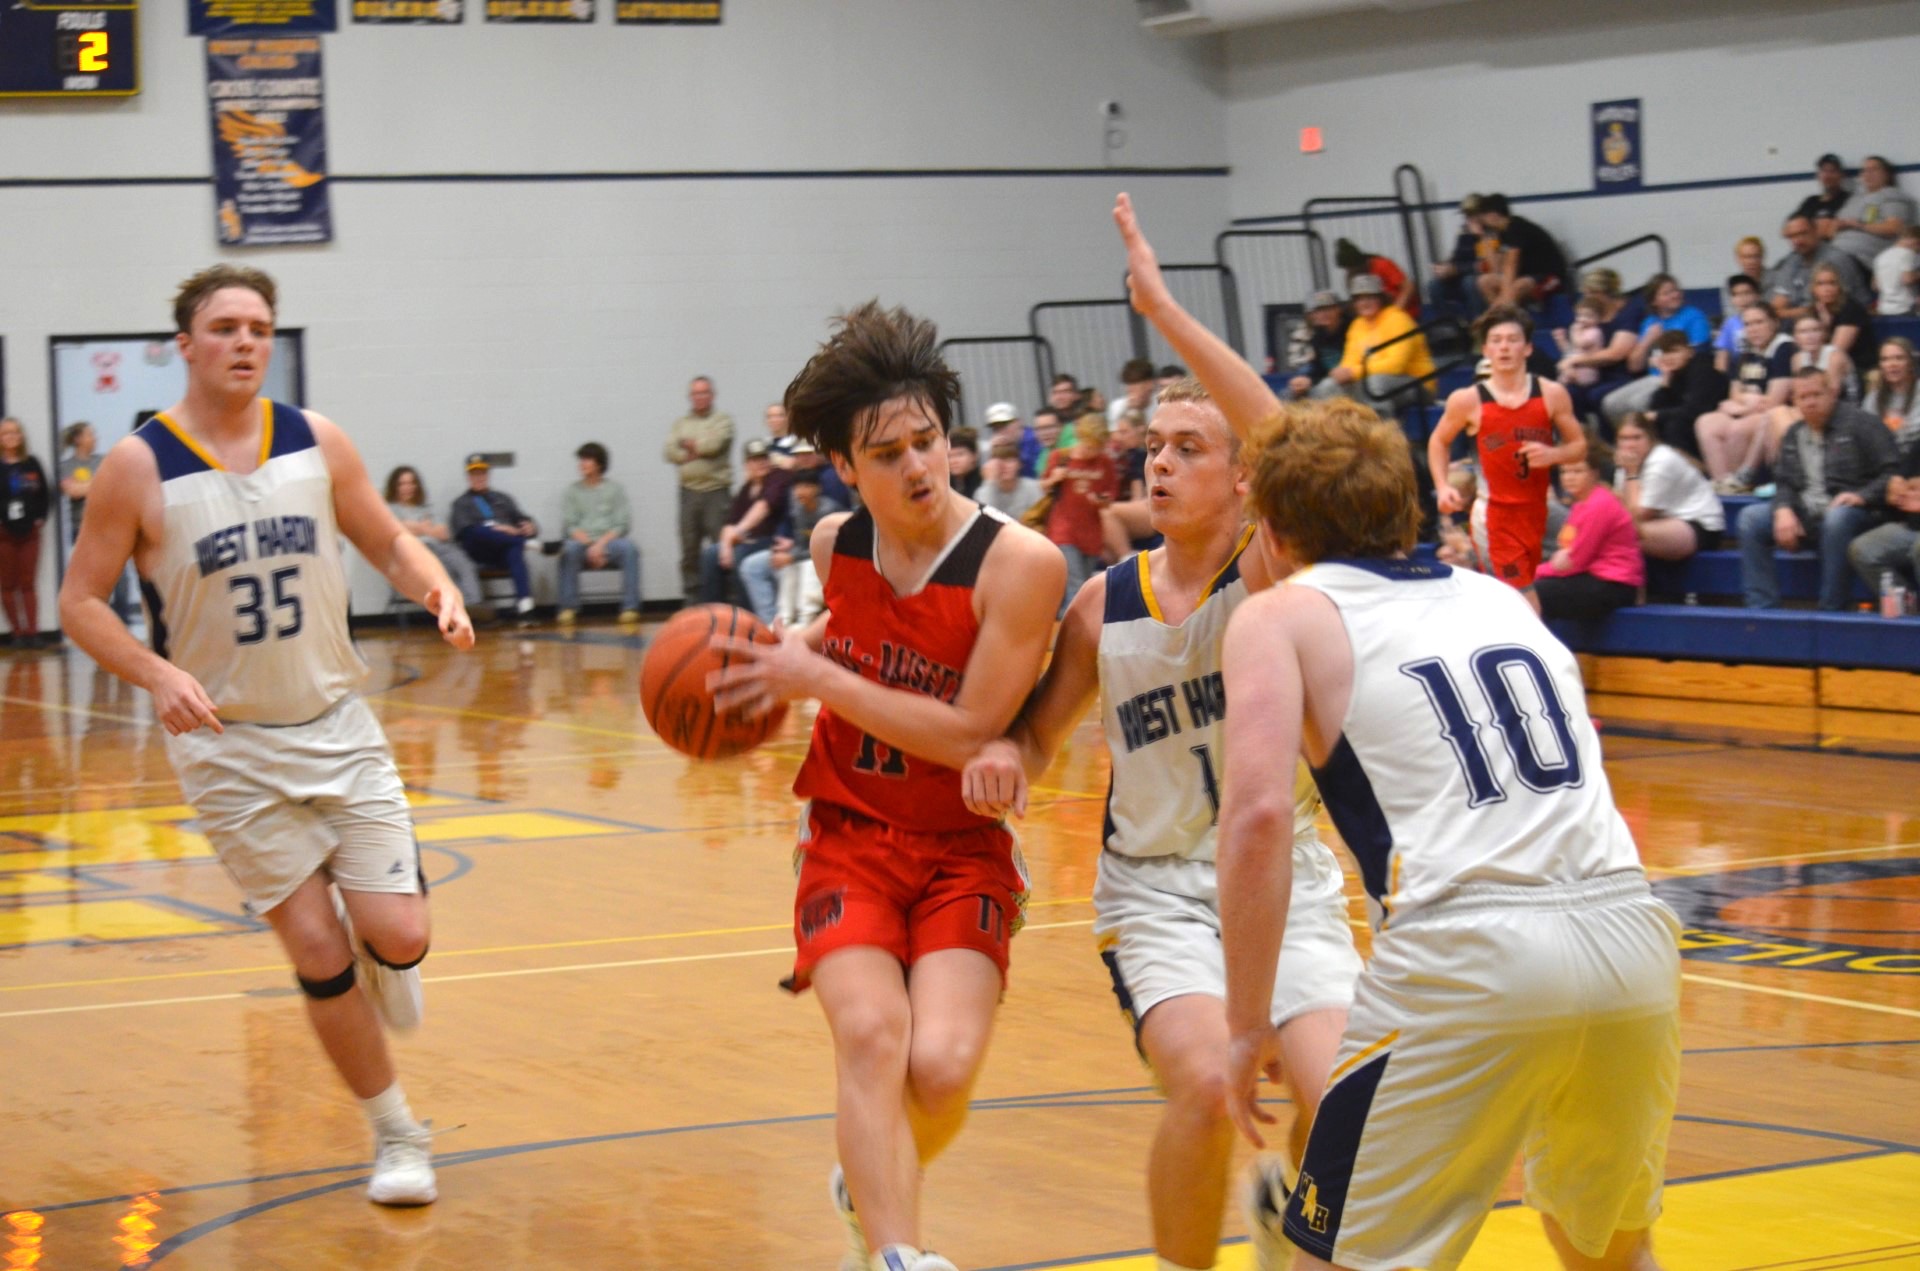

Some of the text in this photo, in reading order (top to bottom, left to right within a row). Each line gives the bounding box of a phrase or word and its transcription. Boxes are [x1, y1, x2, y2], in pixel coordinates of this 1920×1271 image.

[78, 31, 108, 72] 2
[194, 523, 247, 578] WEST
[229, 565, 302, 645] 35
[1117, 684, 1181, 753] WEST
[1399, 643, 1584, 809] 10
